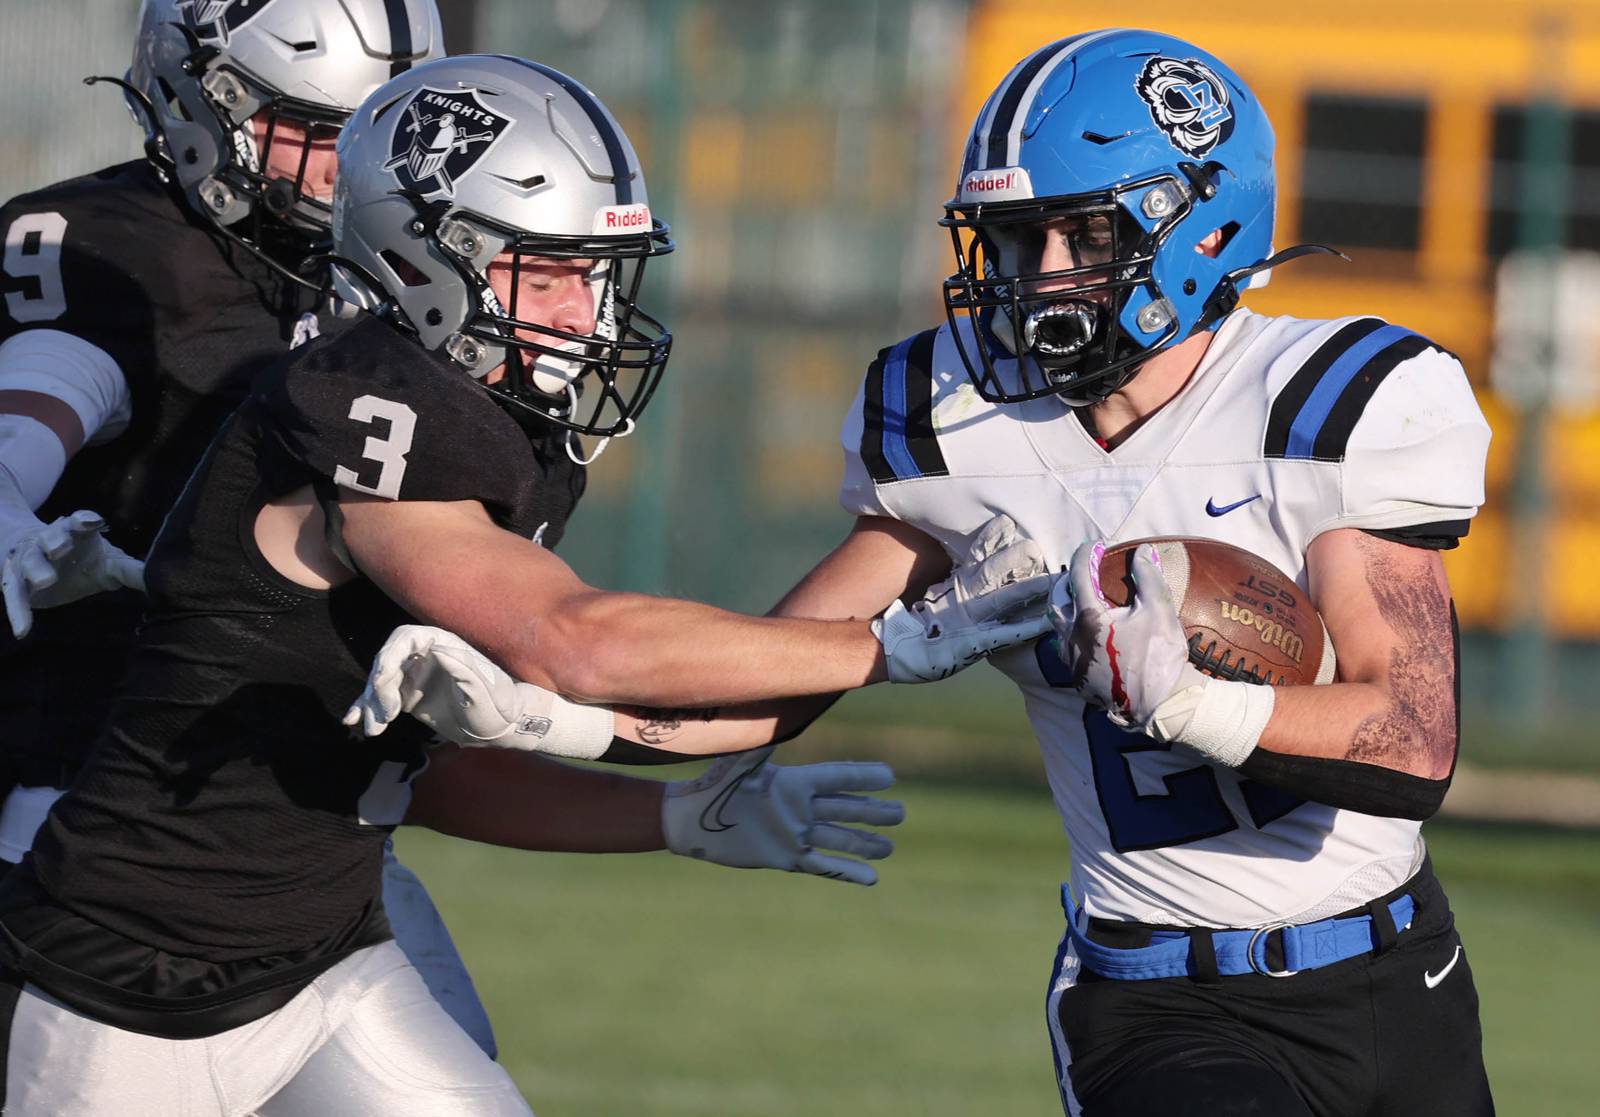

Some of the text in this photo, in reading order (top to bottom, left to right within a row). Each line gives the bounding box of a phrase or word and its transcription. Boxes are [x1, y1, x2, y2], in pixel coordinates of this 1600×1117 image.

[423, 93, 495, 126] KNIGHTS
[3, 211, 68, 324] 9
[333, 394, 417, 501] 3
[1238, 575, 1297, 608] GST
[1219, 600, 1305, 662] Wilson
